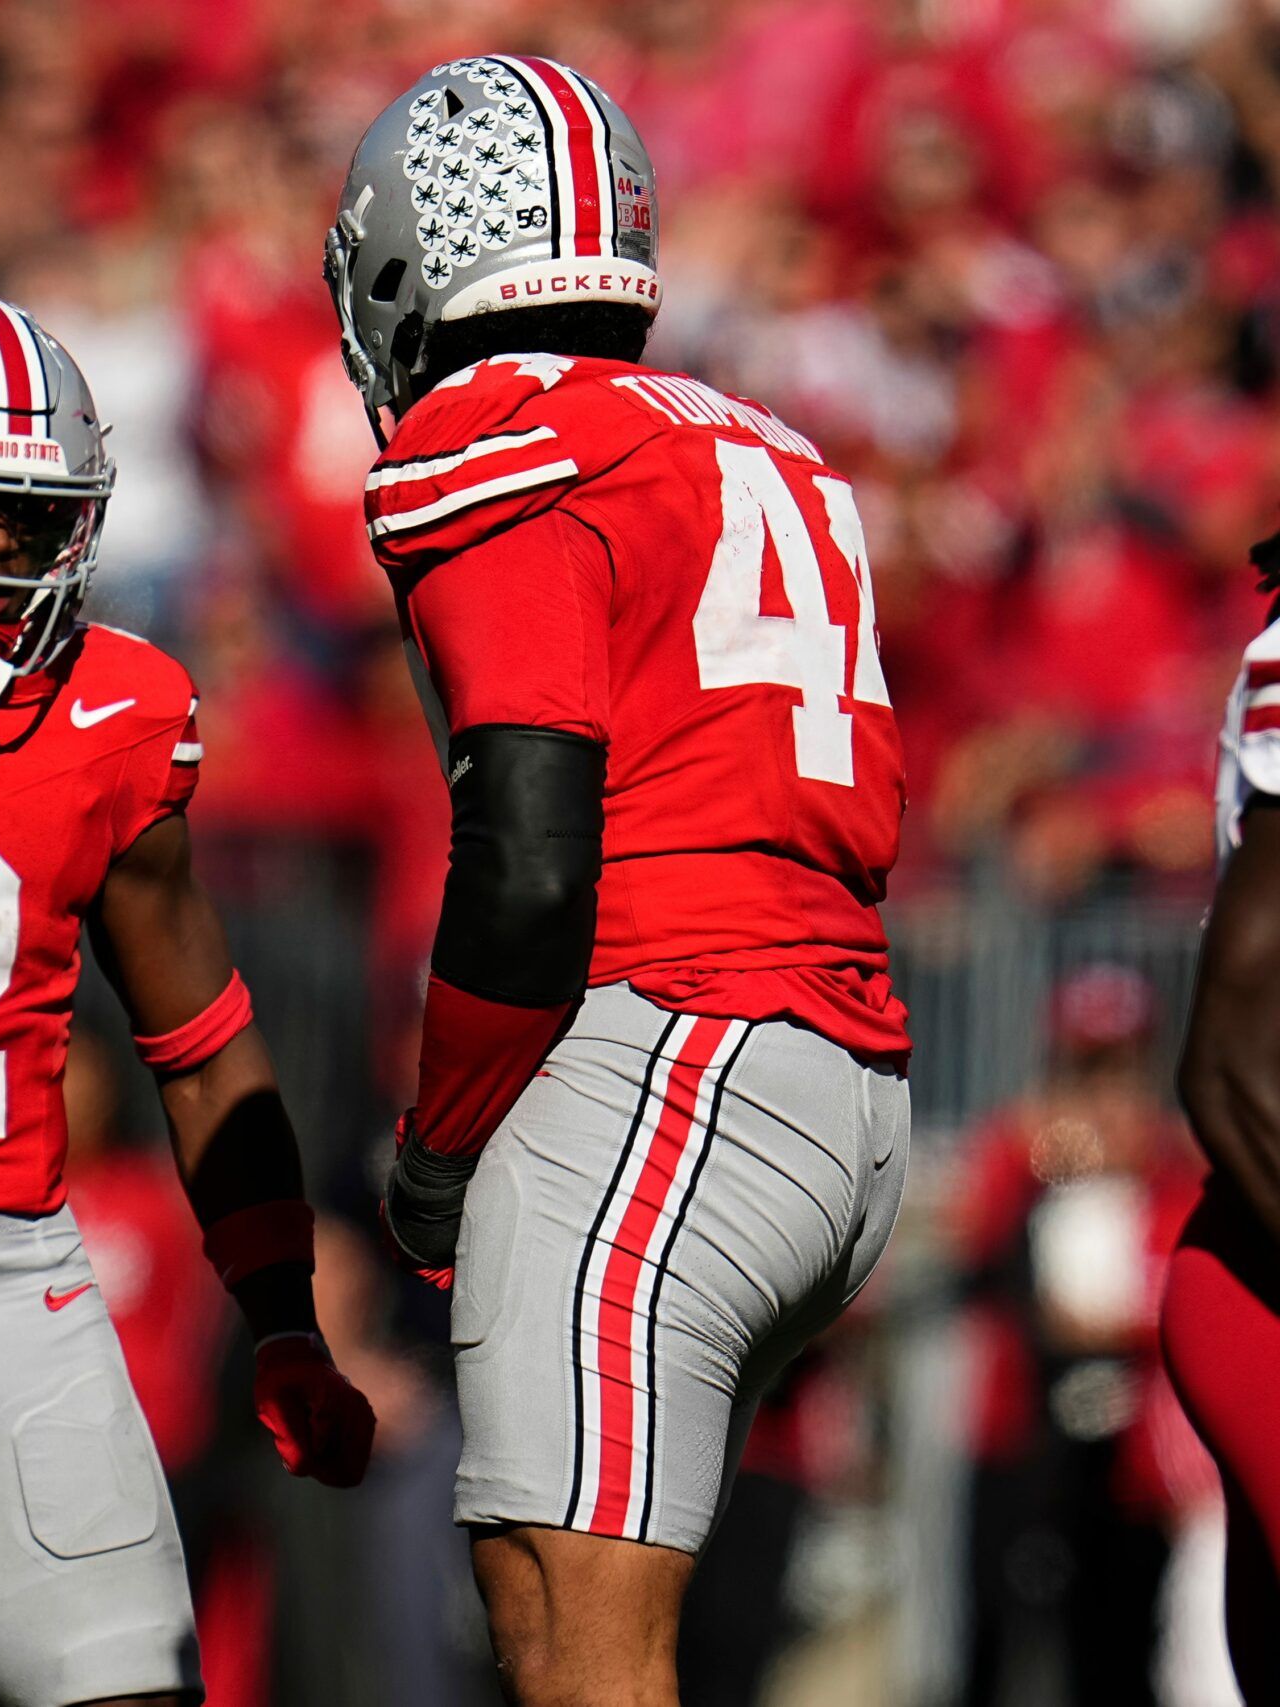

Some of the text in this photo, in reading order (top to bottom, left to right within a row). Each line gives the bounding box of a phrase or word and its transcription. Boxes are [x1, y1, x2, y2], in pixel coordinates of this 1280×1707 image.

[618, 177, 633, 196] 44
[24, 443, 60, 463] STATE
[693, 437, 893, 787] 44
